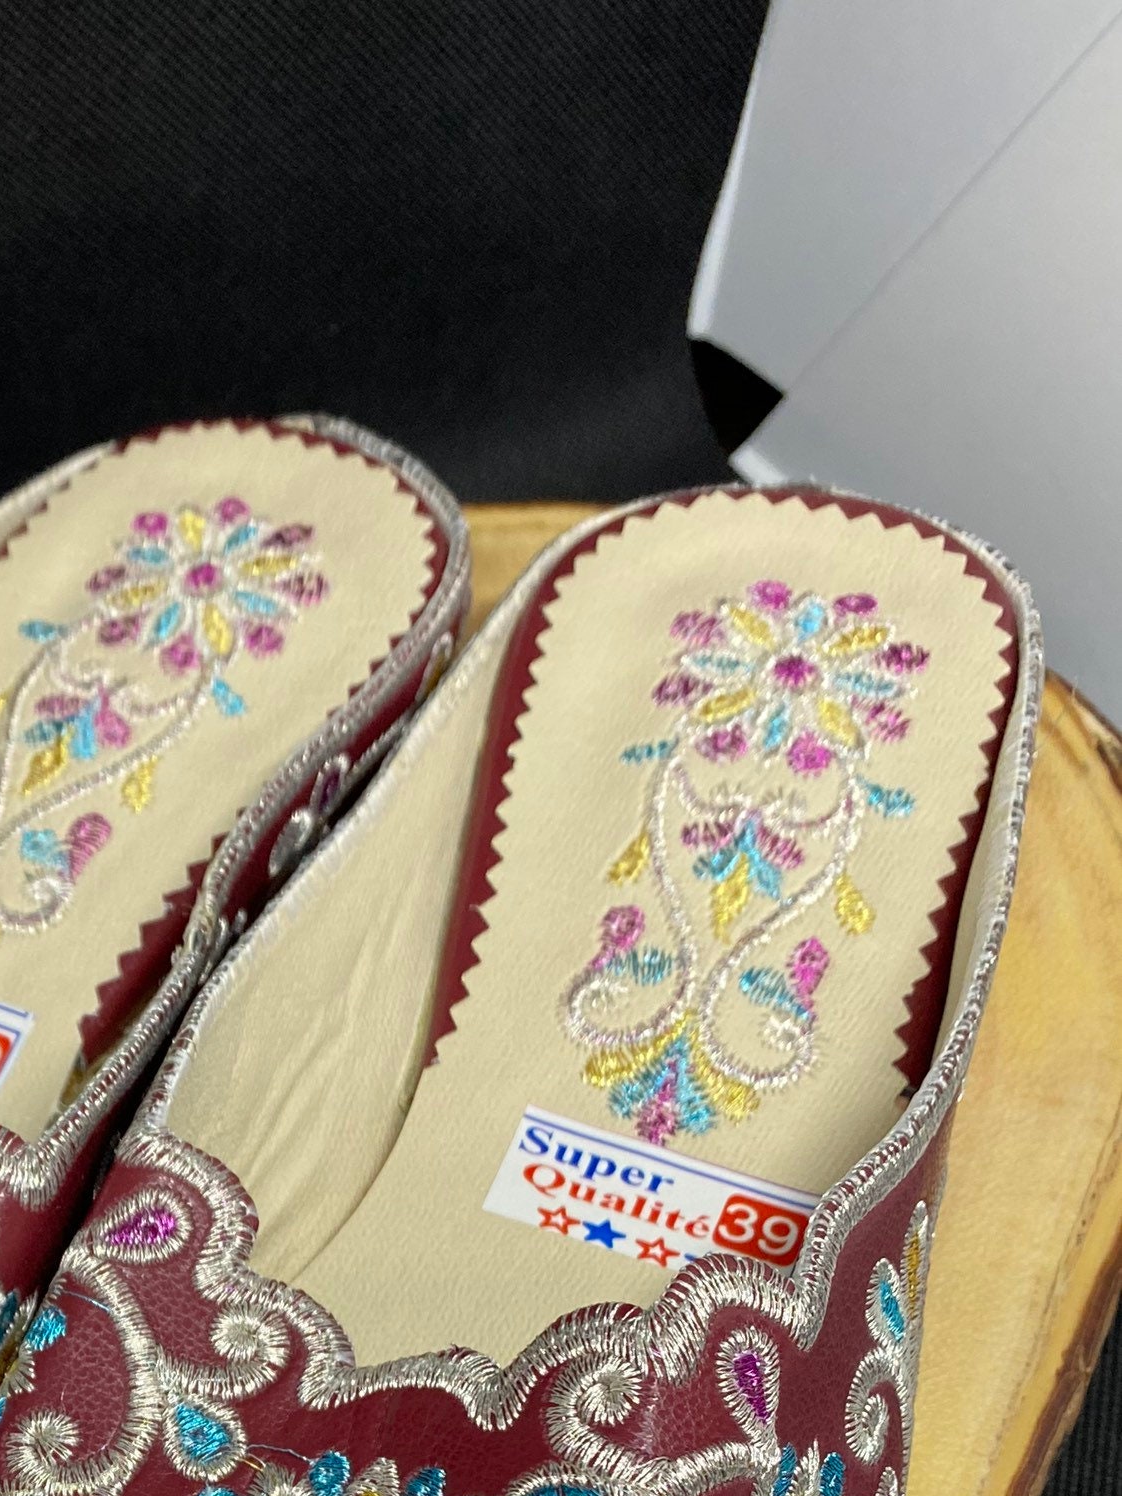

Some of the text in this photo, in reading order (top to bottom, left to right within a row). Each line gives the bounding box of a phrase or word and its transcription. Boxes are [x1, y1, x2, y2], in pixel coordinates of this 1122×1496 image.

[519, 1126, 674, 1194] Super
[523, 1163, 710, 1239] Qualité
[718, 1203, 799, 1256] 39
